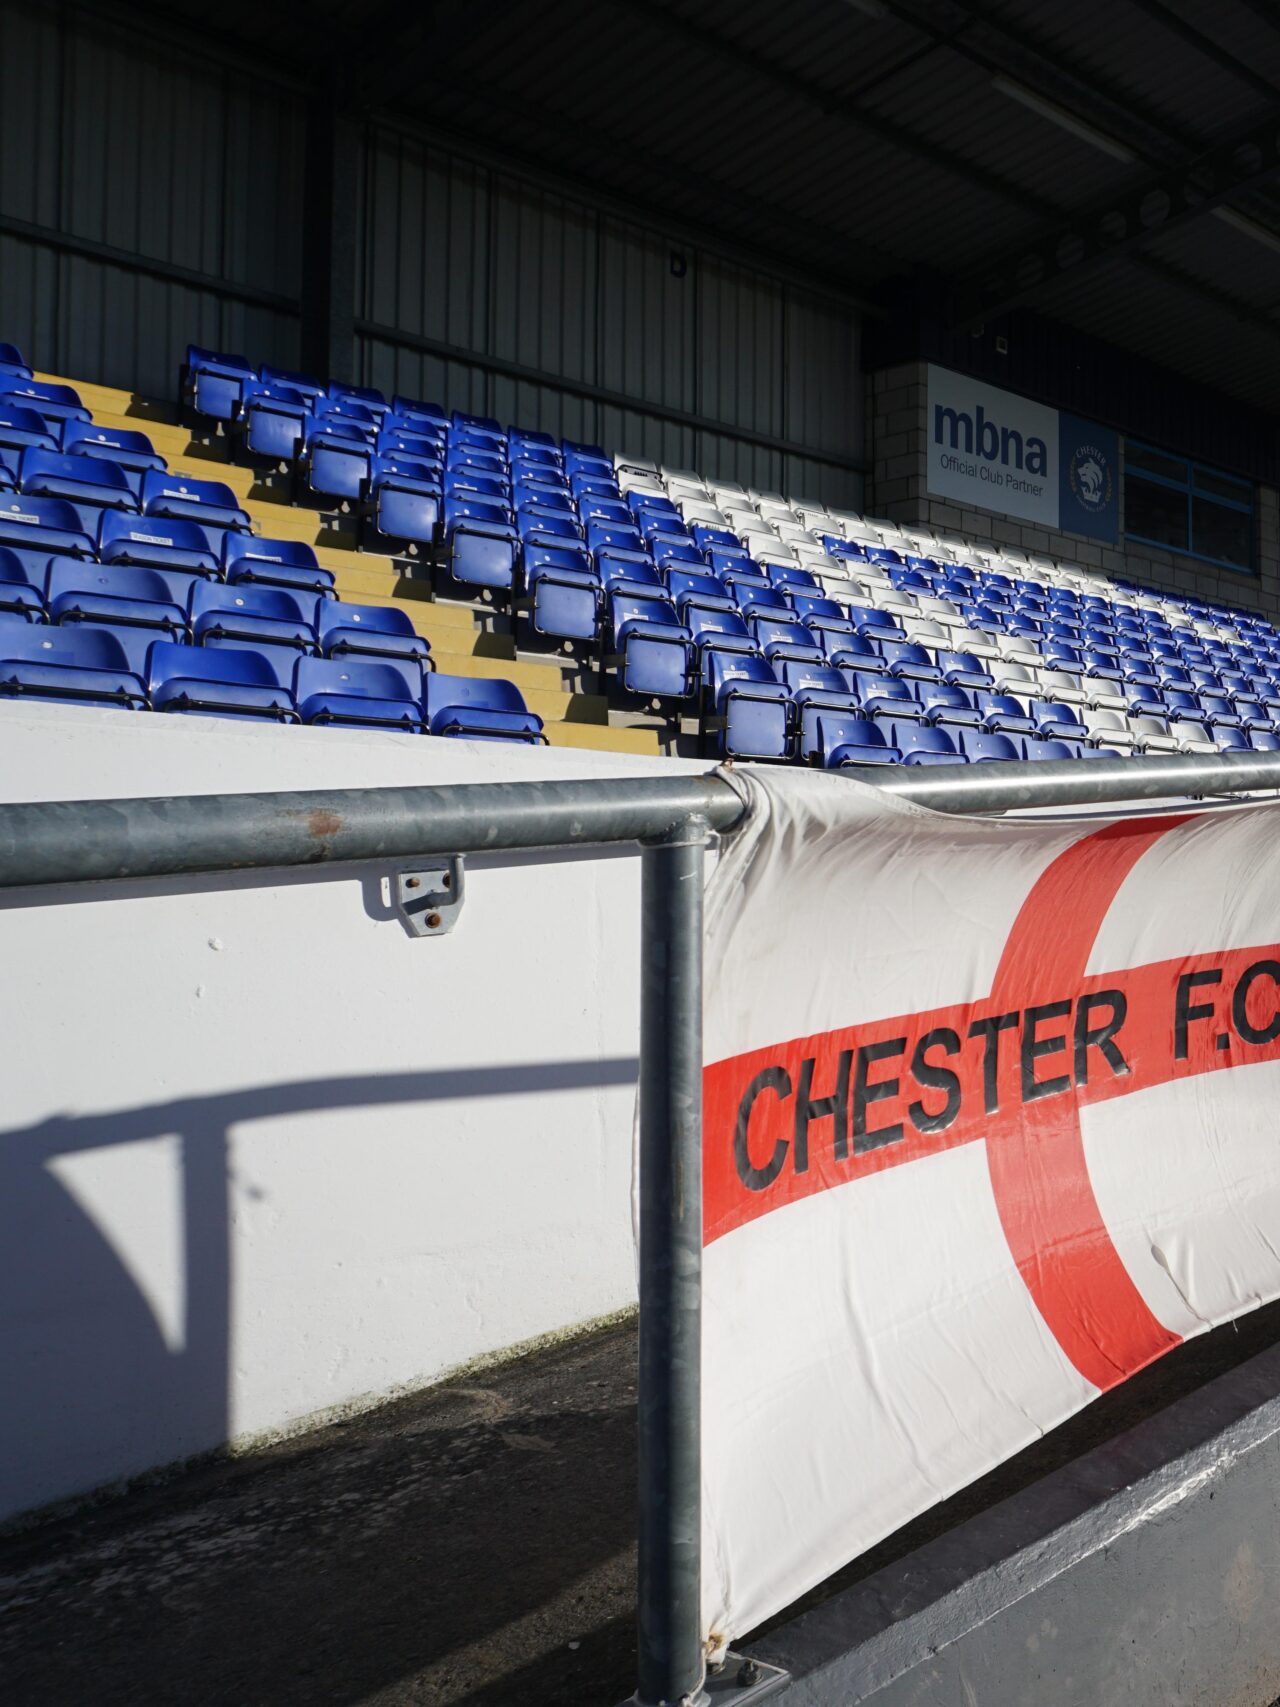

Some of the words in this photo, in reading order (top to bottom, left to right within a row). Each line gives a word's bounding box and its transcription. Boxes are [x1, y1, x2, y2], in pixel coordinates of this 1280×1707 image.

[934, 404, 1047, 478] mbna
[1076, 446, 1106, 467] CHESTER
[940, 453, 978, 478] Official
[979, 465, 1004, 487] Club
[1005, 474, 1045, 497] Partner
[734, 989, 1131, 1191] CHESTER
